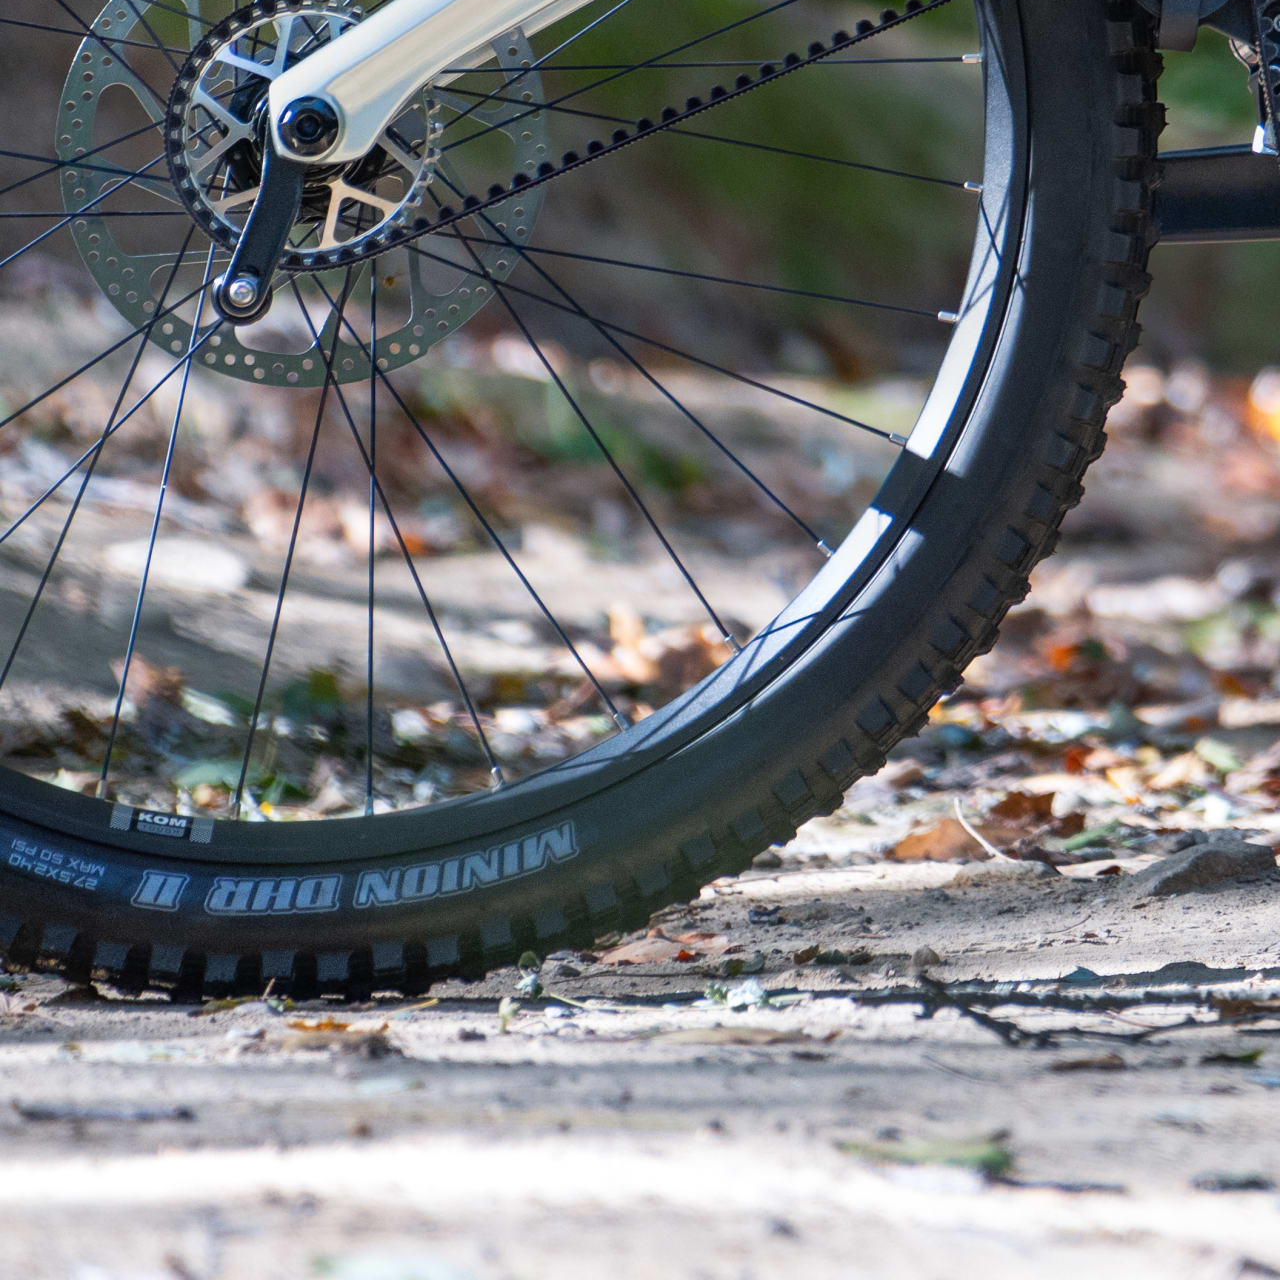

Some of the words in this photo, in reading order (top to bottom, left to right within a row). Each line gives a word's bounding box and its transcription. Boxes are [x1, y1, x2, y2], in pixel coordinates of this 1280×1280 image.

[138, 812, 187, 828] KOM
[11, 839, 37, 858] PSI
[8, 852, 98, 891] 27.5X2.40
[67, 857, 105, 877] MAX
[353, 820, 579, 908] MINION
[205, 873, 343, 916] DHR
